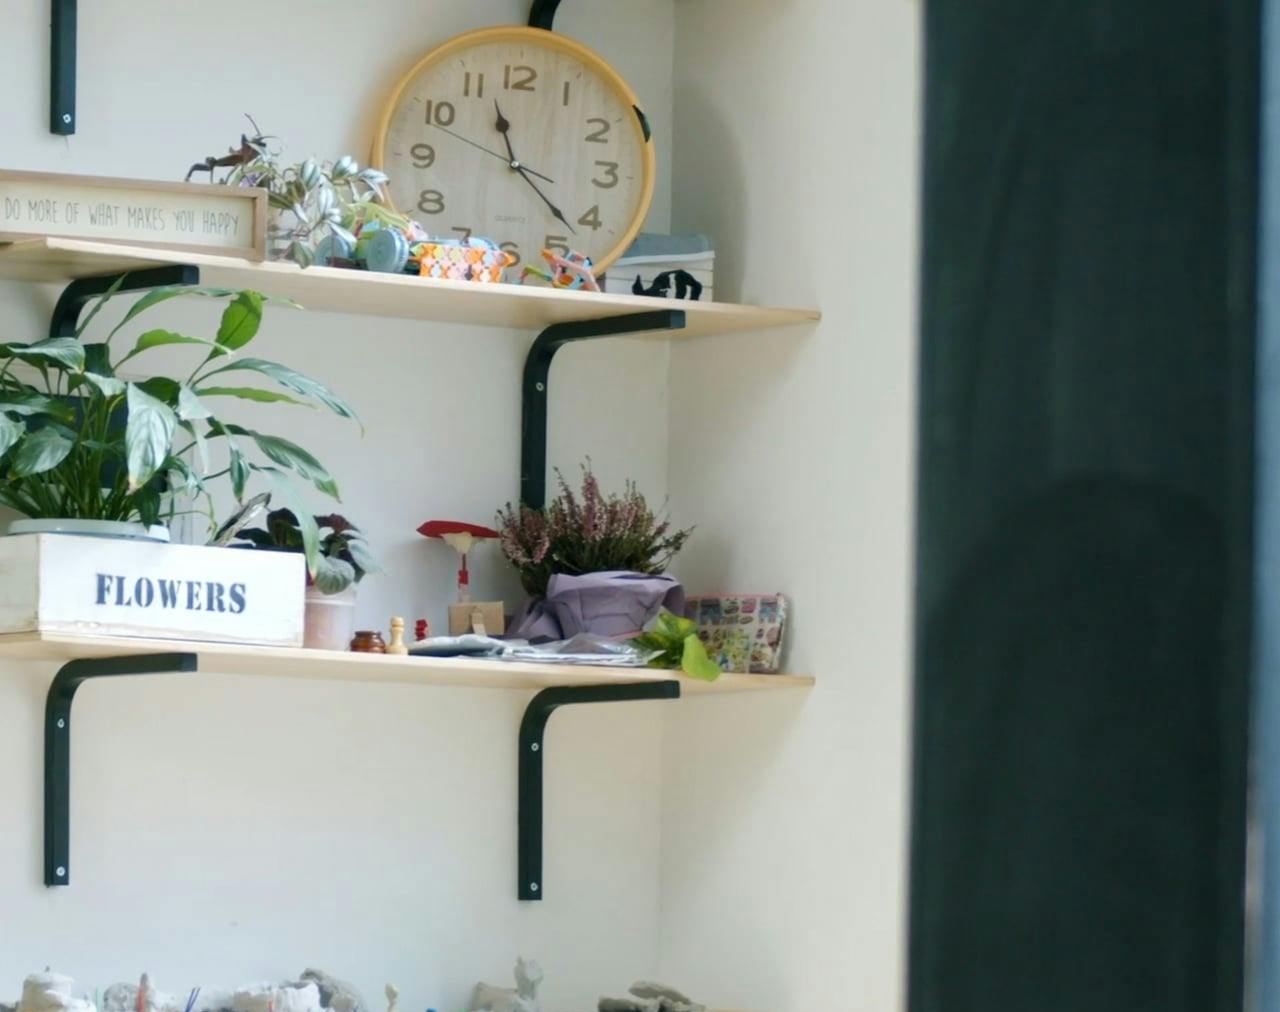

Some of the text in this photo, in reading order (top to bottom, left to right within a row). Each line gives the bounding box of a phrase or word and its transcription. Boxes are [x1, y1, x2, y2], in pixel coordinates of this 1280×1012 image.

[463, 72, 484, 98] 11
[503, 64, 537, 91] 12
[562, 81, 570, 106] 1
[425, 100, 455, 126] 10
[585, 118, 610, 143] 2
[410, 143, 435, 169] 9
[591, 160, 618, 188] 3
[417, 189, 445, 215] 8
[4, 196, 239, 236] DO MORE OF WHAT MAKES YOU HAPPY
[577, 204, 602, 231] 4
[95, 573, 247, 614] FLOWERS
